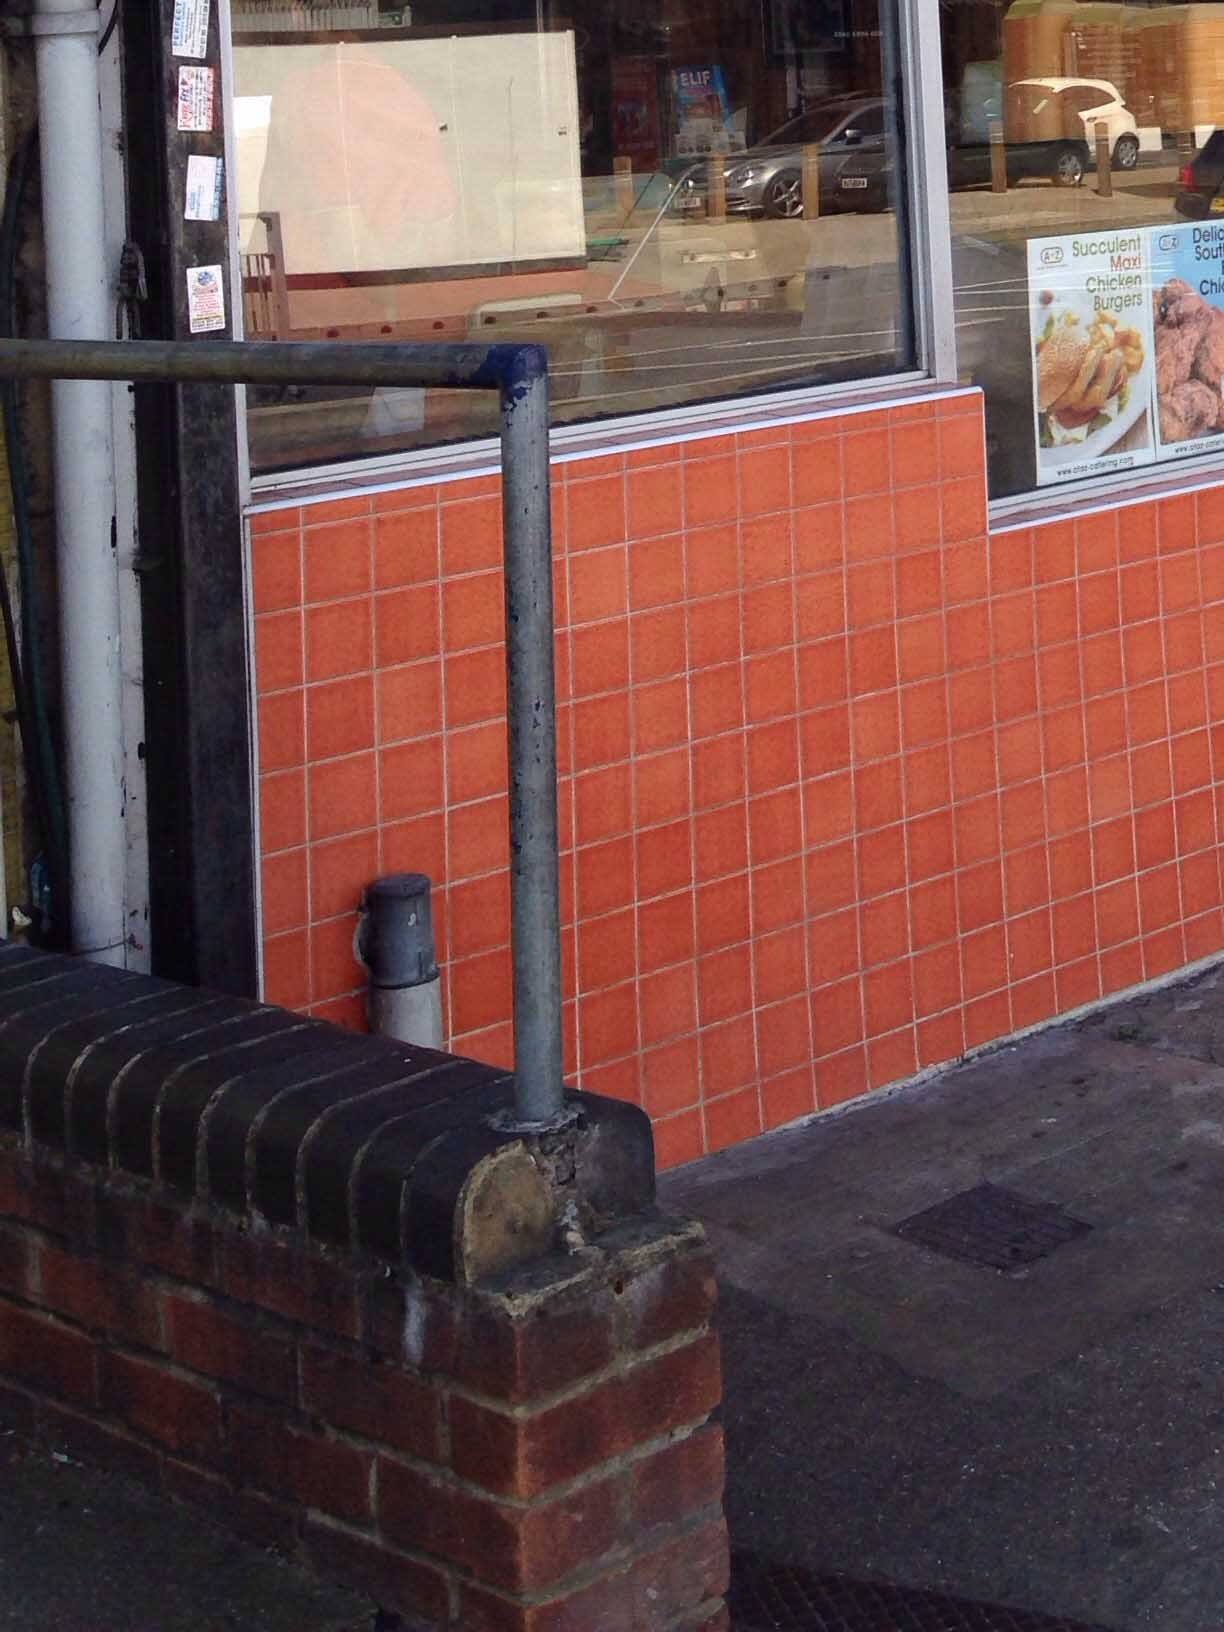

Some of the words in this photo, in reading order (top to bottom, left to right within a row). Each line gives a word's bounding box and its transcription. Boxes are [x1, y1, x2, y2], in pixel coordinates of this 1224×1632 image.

[680, 71, 711, 86] ELIF
[1072, 234, 1141, 257] Succulent
[1110, 253, 1142, 272] Maxi
[1086, 273, 1142, 293] Chicken
[1093, 293, 1143, 313] Burgers
